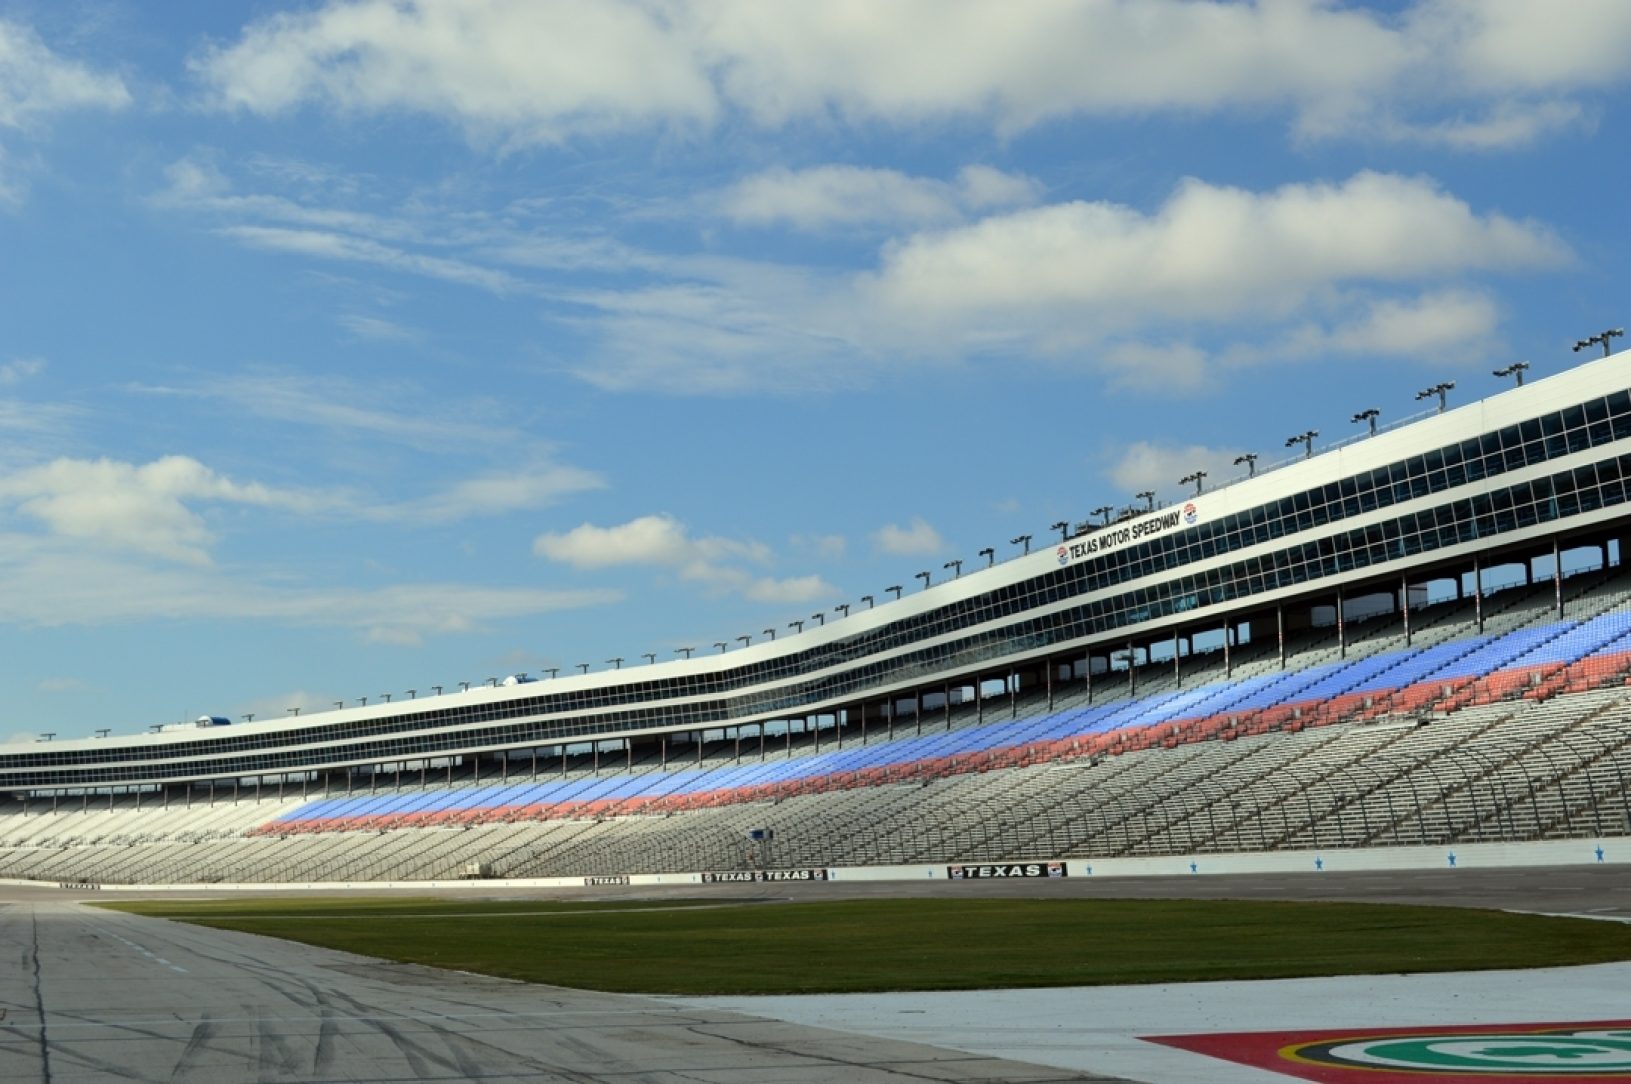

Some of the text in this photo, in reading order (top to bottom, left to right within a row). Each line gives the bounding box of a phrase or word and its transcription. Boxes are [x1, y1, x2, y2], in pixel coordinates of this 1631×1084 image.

[1069, 539, 1098, 559] TEXAS
[1099, 528, 1130, 547] MOTOR
[1132, 511, 1181, 539] SPEEDWAY
[766, 870, 809, 880] TEXAS
[965, 865, 1040, 877] TEXAS
[716, 873, 751, 881] TEXAS
